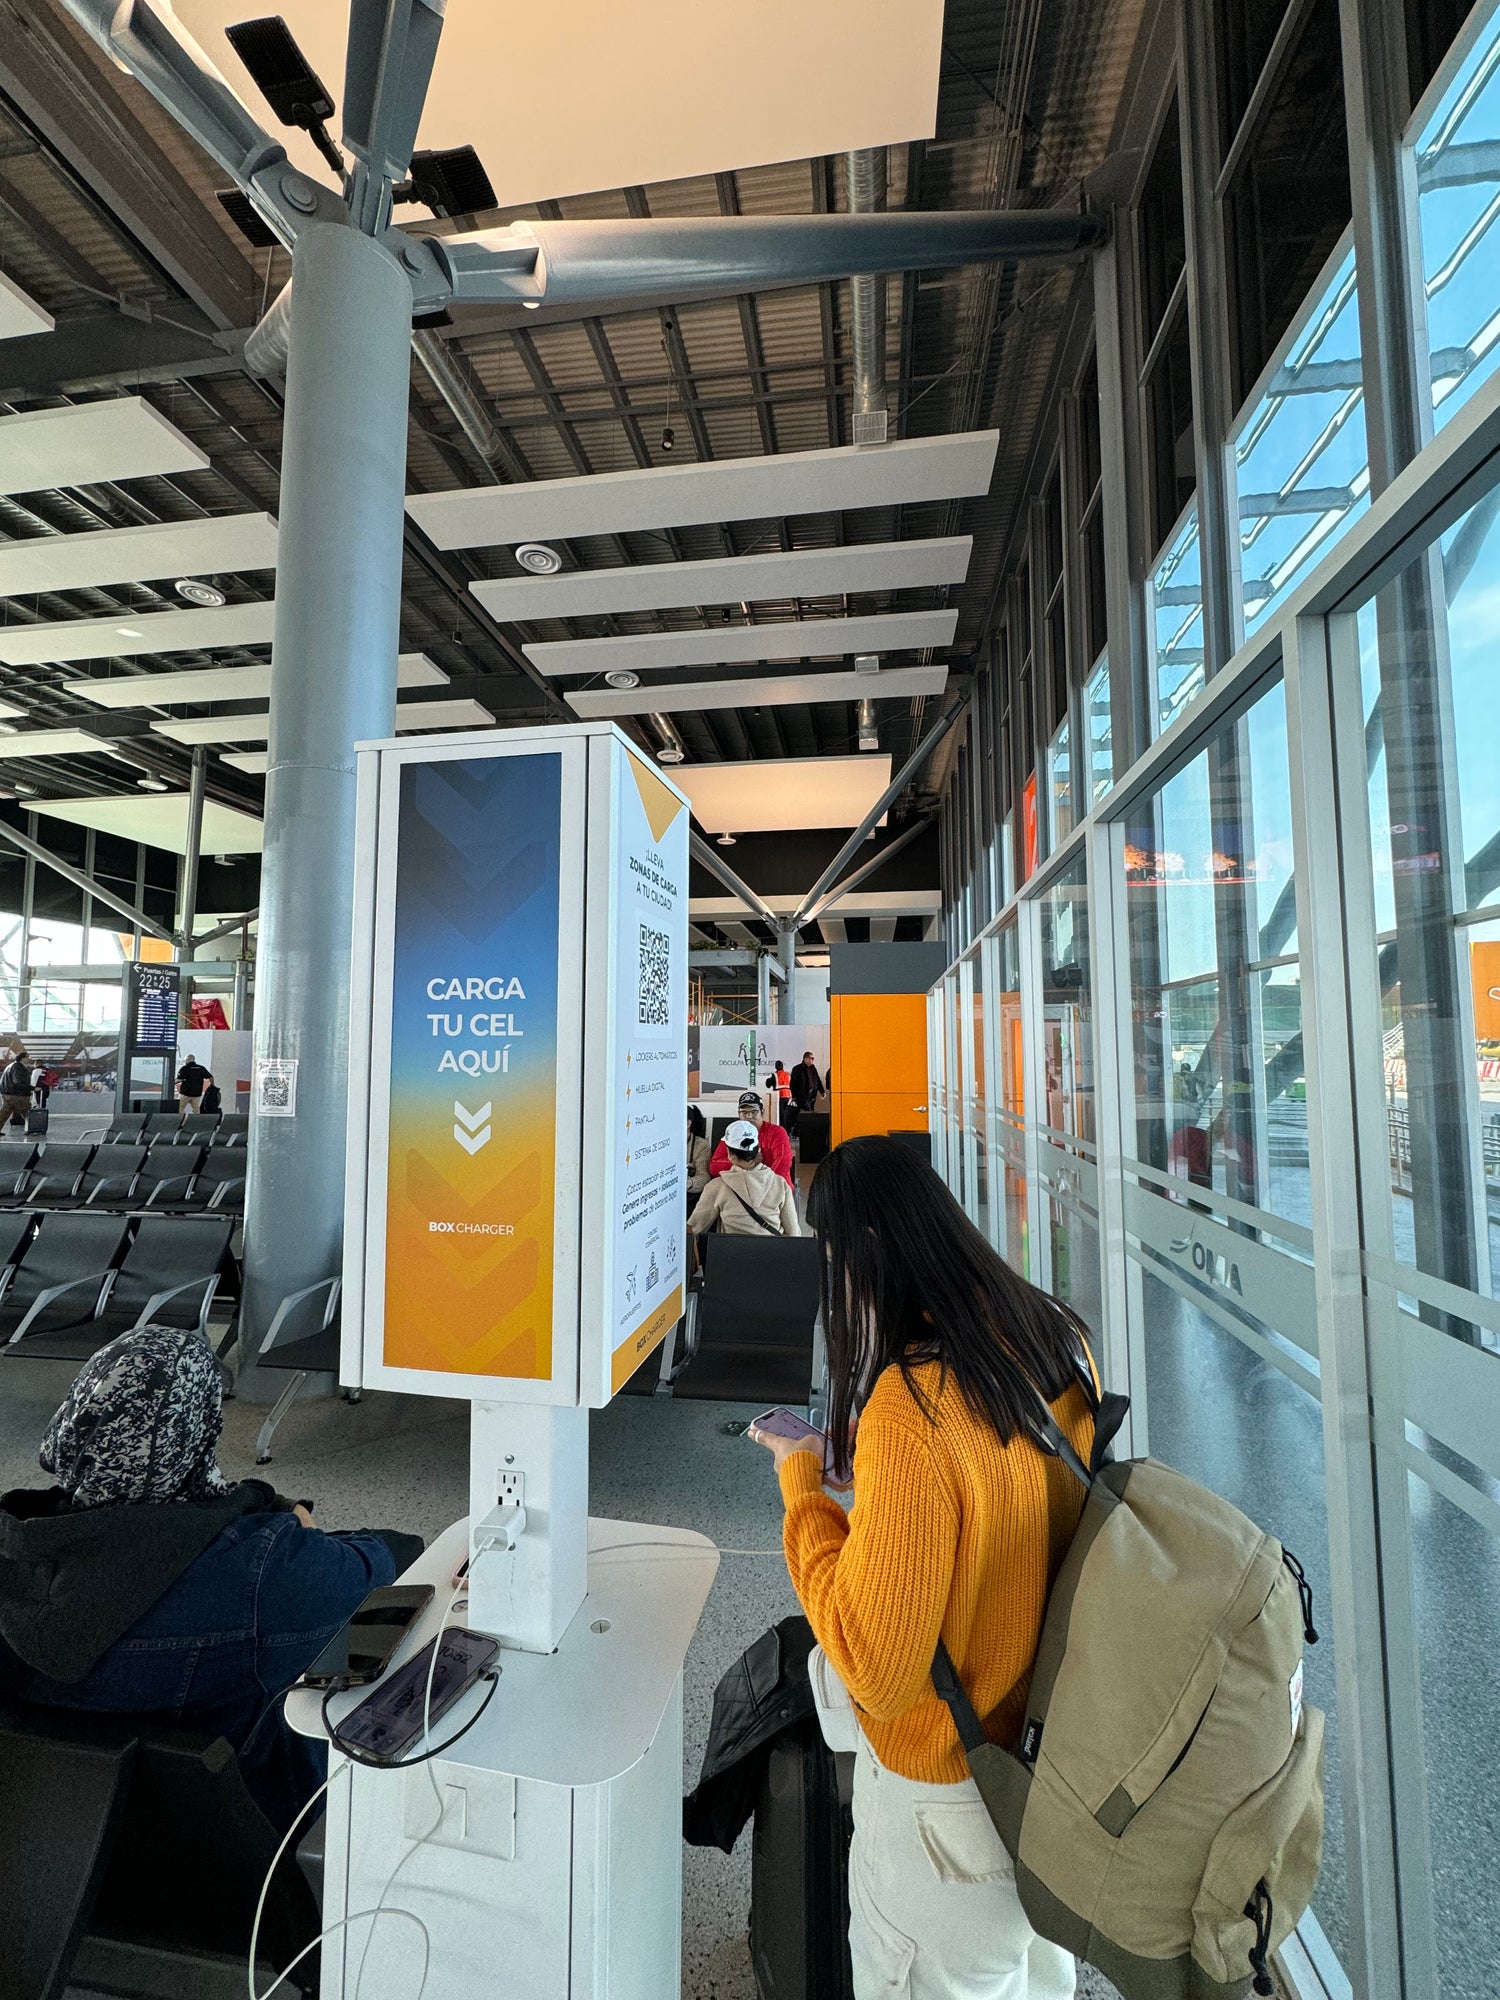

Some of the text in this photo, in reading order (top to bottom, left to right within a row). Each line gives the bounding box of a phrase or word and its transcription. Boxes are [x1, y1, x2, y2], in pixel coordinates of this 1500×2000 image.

[645, 849, 665, 871] ¡LLEVA
[630, 855, 678, 898] ZONAS DE CARGA
[636, 881, 673, 912] A TU CIUDAD!
[139, 973, 153, 988] 22
[158, 975, 171, 990] 25
[426, 976, 527, 1001] CARGA
[426, 1013, 524, 1037] TU CEL
[437, 1043, 513, 1078] AQUÍ
[1191, 1241, 1244, 1297] OMA
